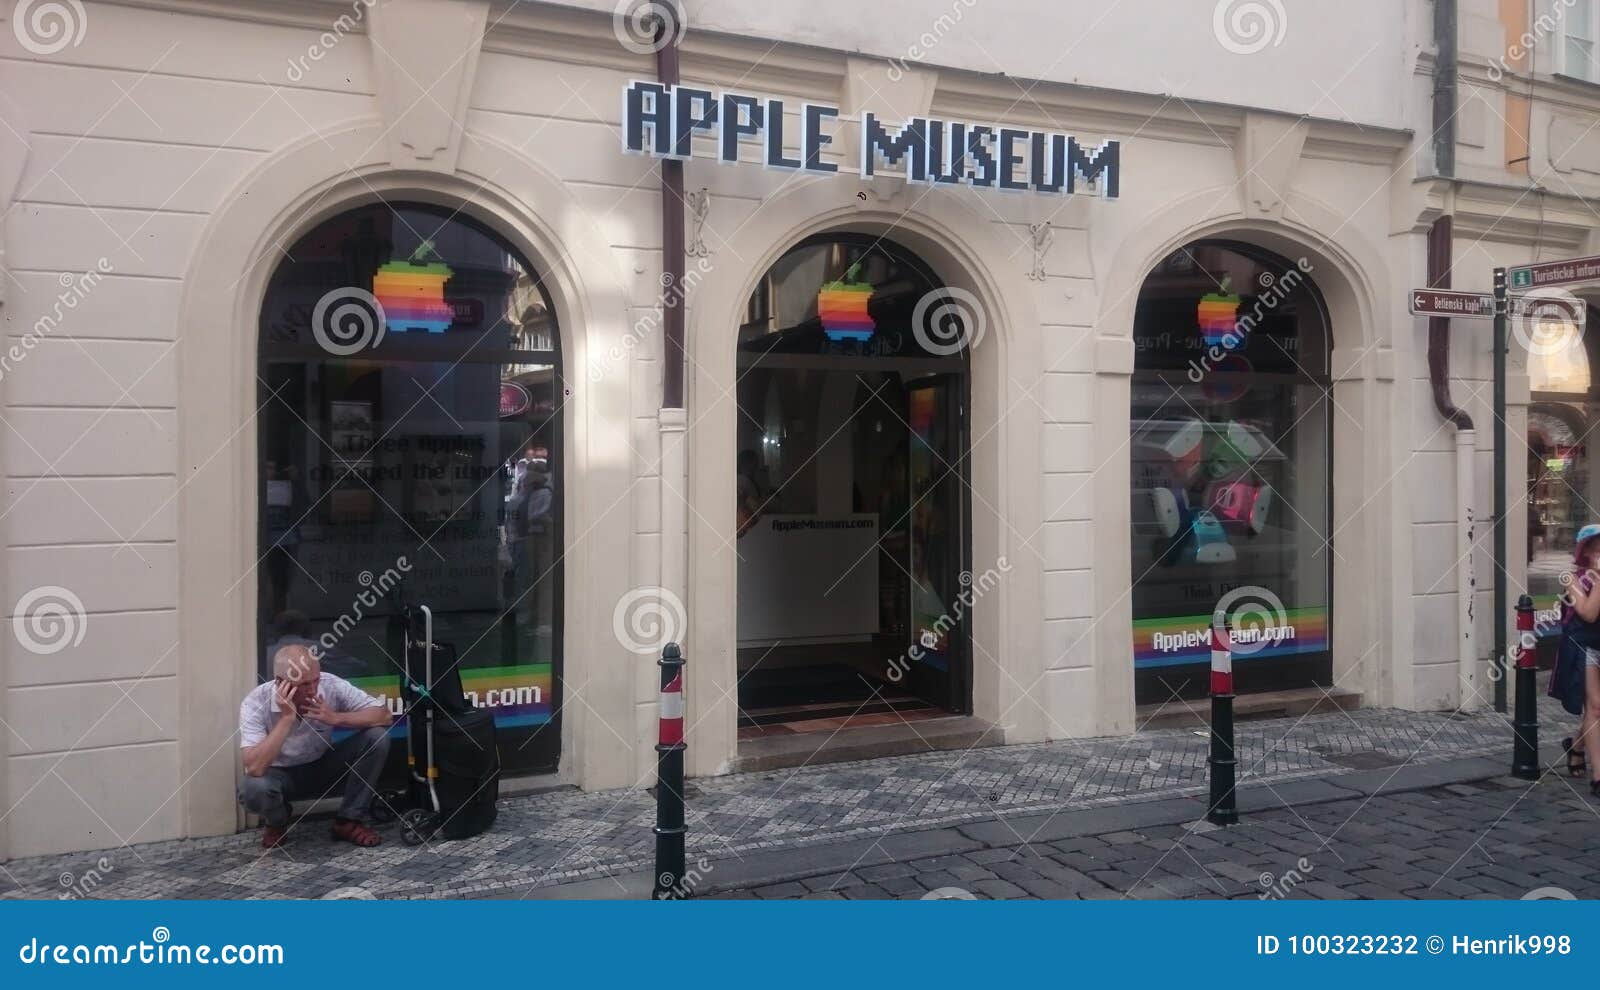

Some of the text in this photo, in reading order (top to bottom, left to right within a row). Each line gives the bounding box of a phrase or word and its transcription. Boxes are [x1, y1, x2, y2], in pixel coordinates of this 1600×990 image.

[624, 80, 1121, 199] APPLE MUSEUM
[1153, 624, 1295, 652] AppleMeum.com
